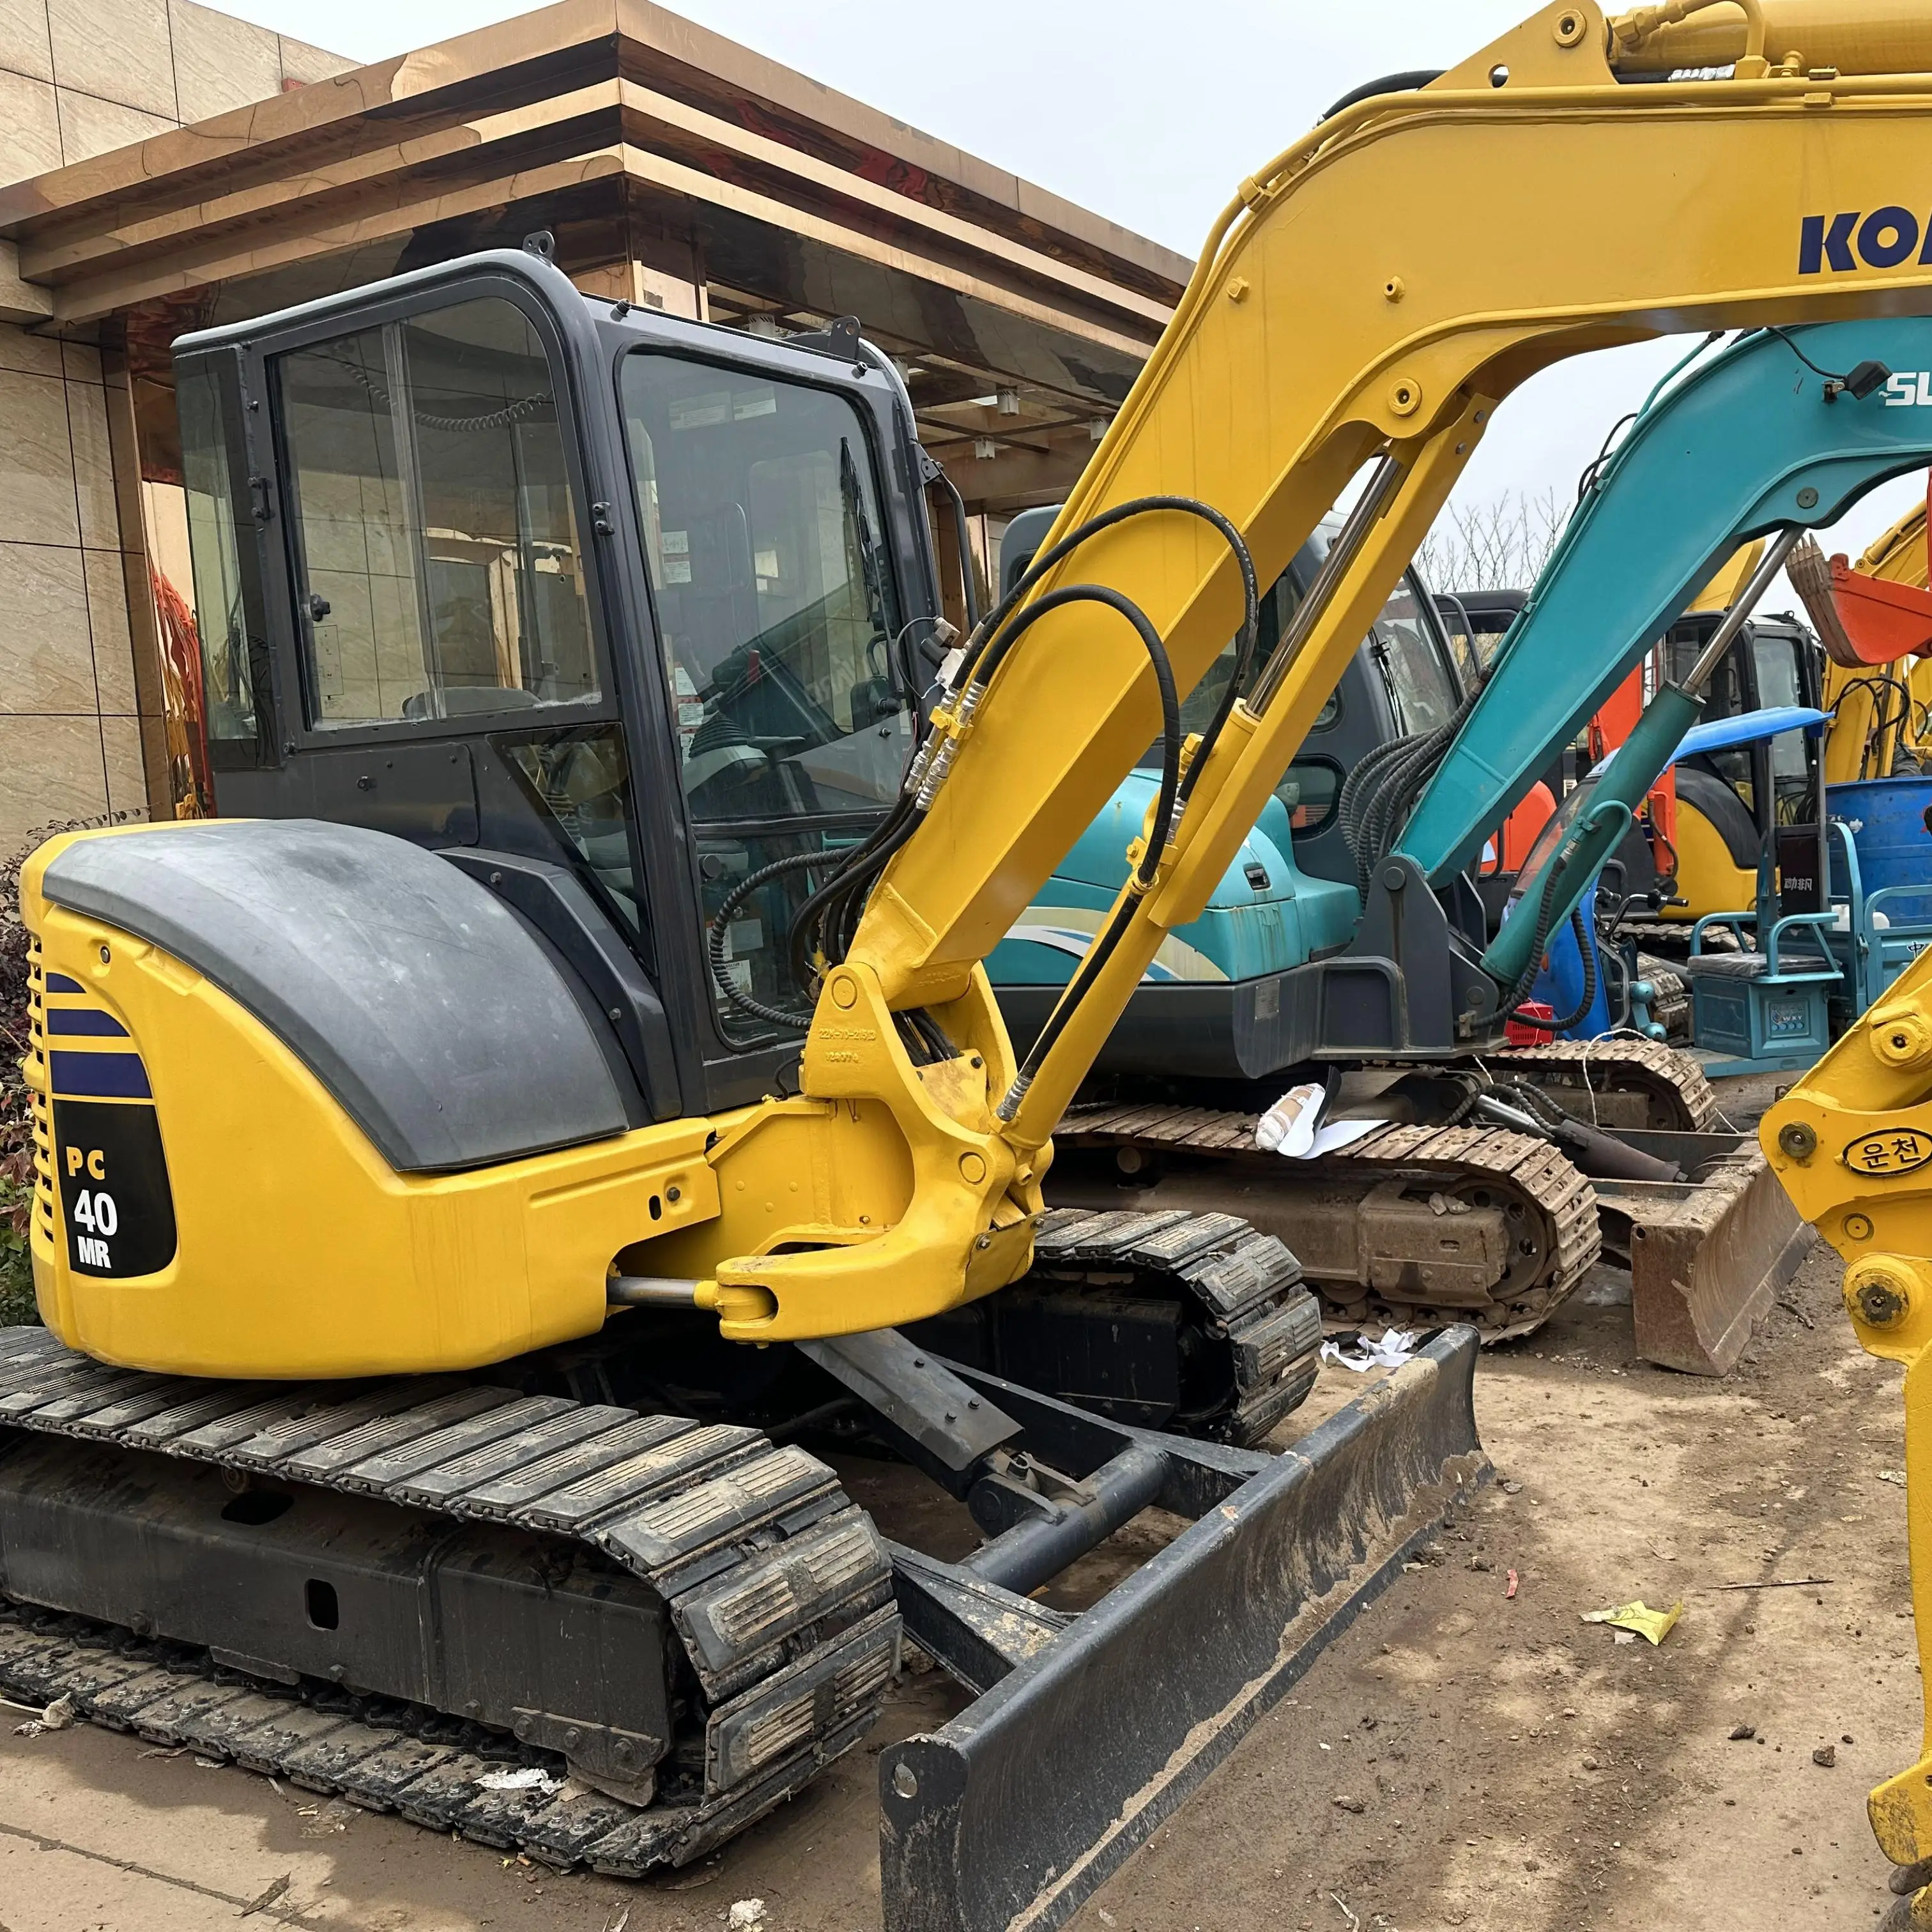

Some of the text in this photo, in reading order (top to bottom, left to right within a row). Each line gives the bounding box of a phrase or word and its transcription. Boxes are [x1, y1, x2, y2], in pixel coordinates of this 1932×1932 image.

[1798, 206, 1932, 274] KO
[66, 1146, 105, 1180] PC
[1861, 1136, 1921, 1169] 운천
[74, 1189, 118, 1236] 40
[77, 1236, 112, 1268] MR
